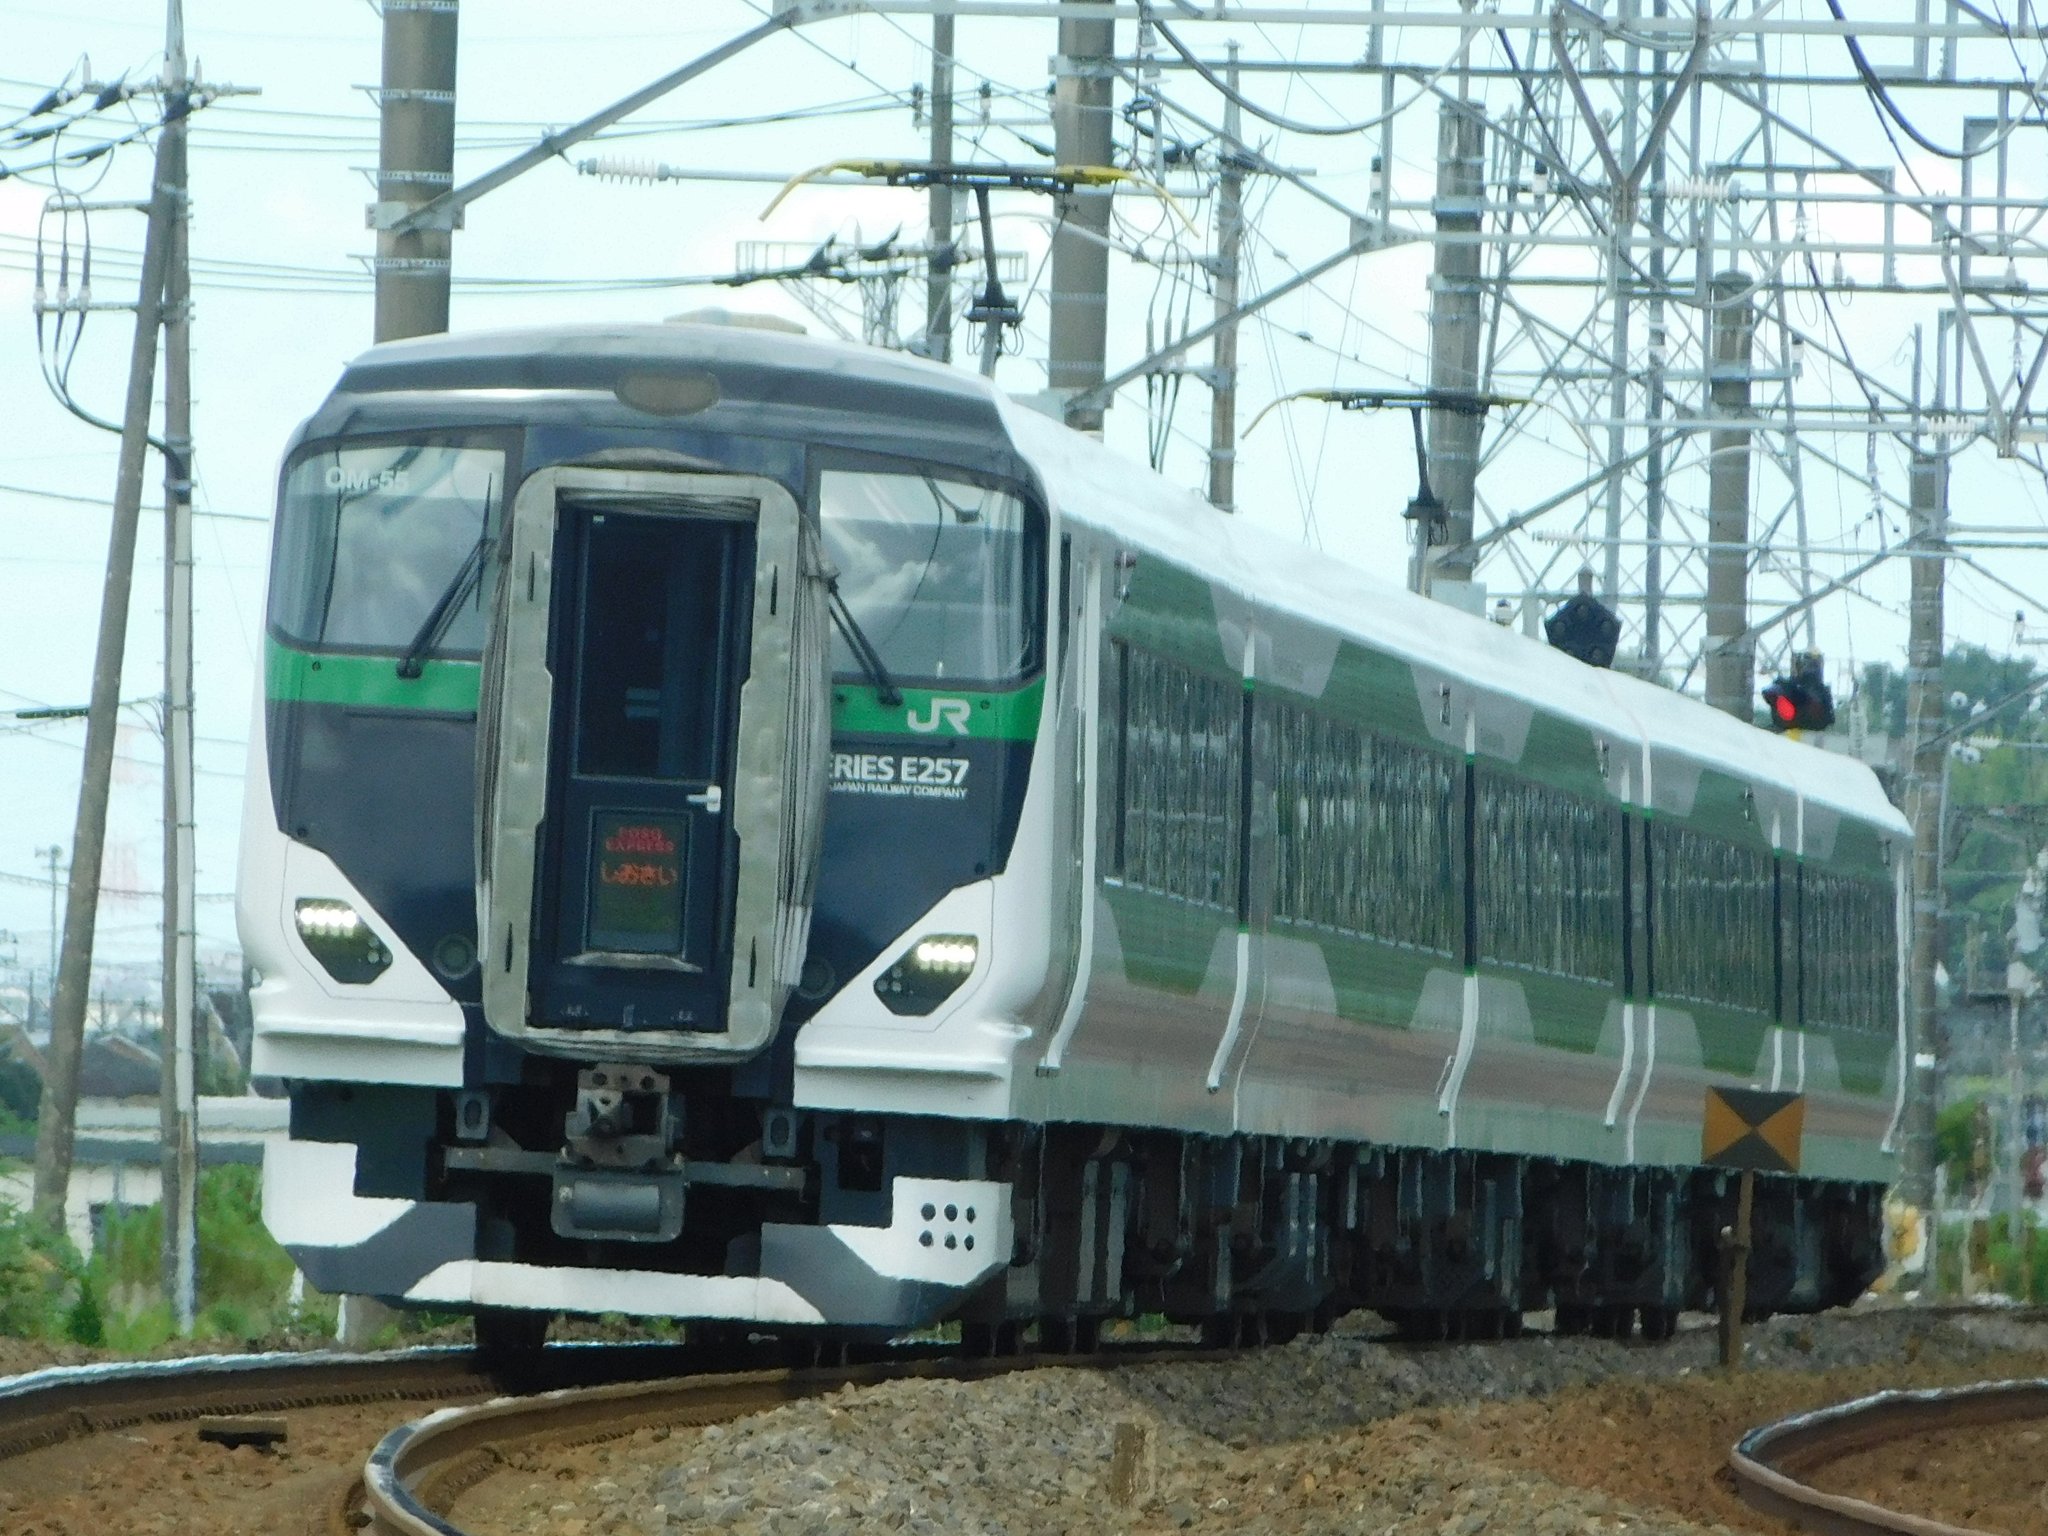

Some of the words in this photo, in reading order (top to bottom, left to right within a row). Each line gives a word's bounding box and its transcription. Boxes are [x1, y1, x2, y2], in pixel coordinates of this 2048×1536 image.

[907, 698, 971, 735] JR
[901, 757, 970, 785] E257
[867, 783, 912, 796] RAILWAY
[913, 785, 968, 799] COMPANY
